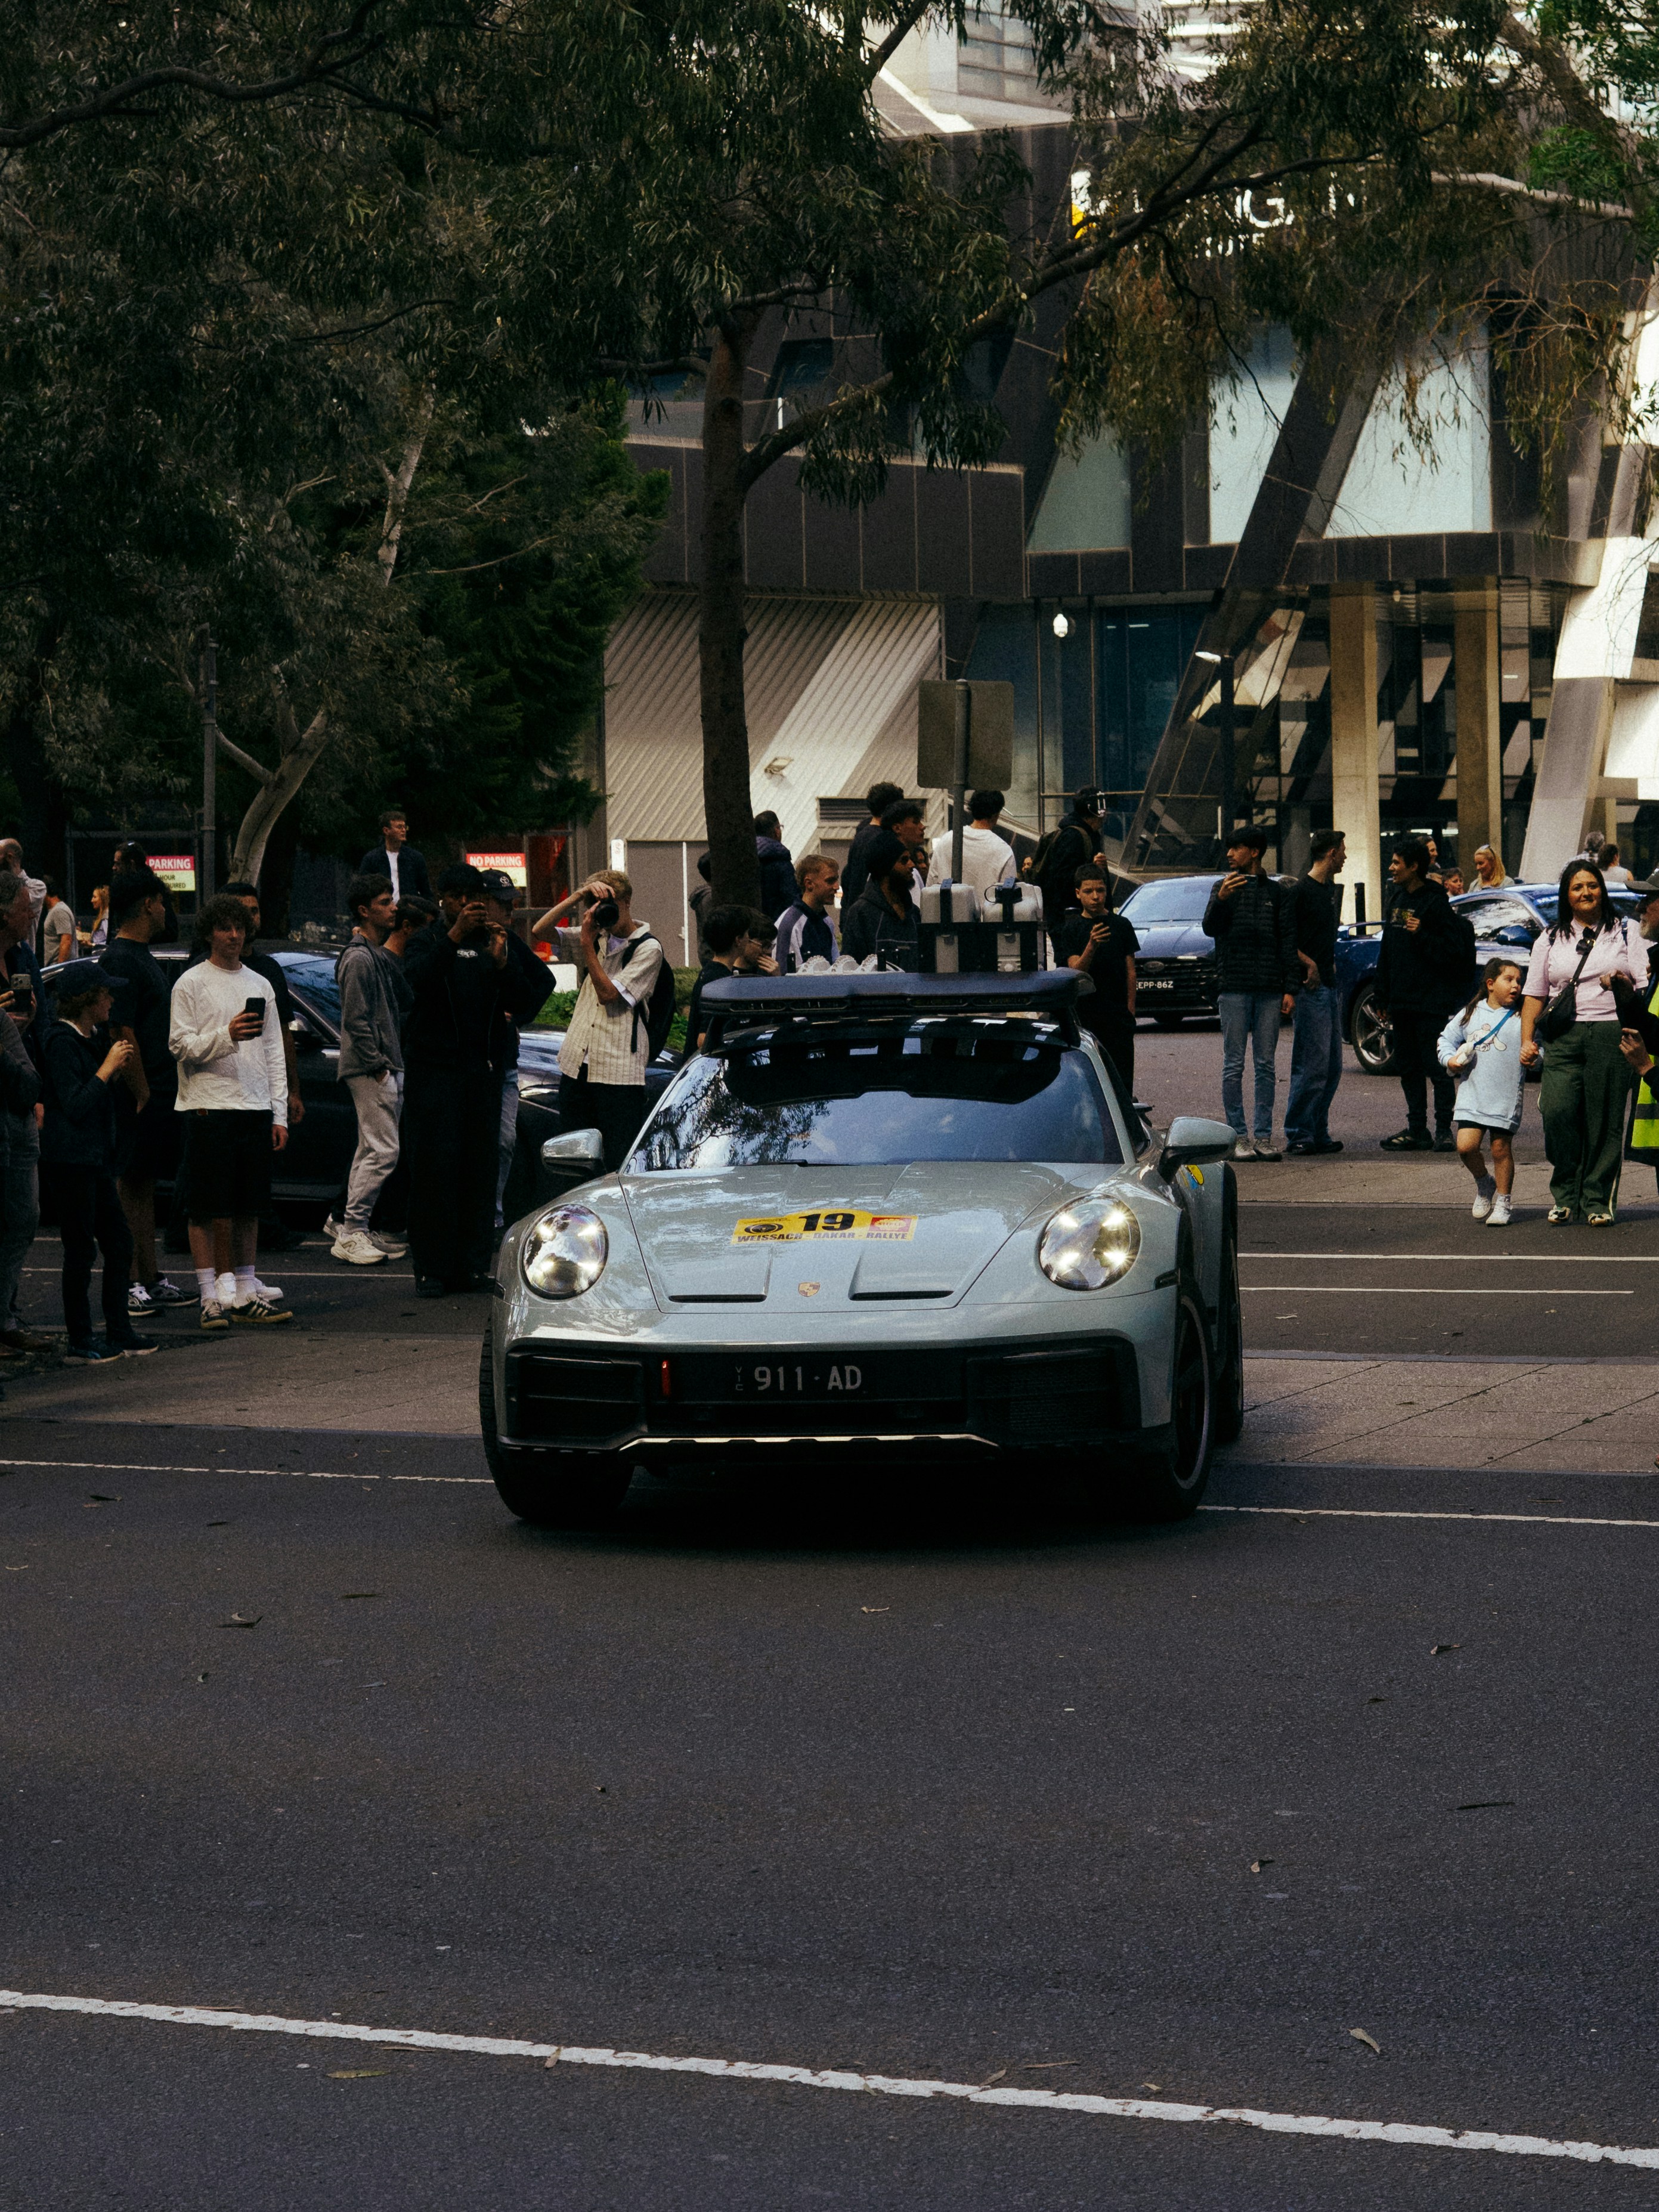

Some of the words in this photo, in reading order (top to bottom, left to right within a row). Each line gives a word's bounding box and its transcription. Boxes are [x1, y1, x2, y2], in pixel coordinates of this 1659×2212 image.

[148, 859, 191, 869] PARKING
[470, 856, 484, 866] NO
[485, 856, 522, 866] PARKING
[798, 1213, 855, 1231] 19
[737, 1233, 803, 1242] WEISSACH
